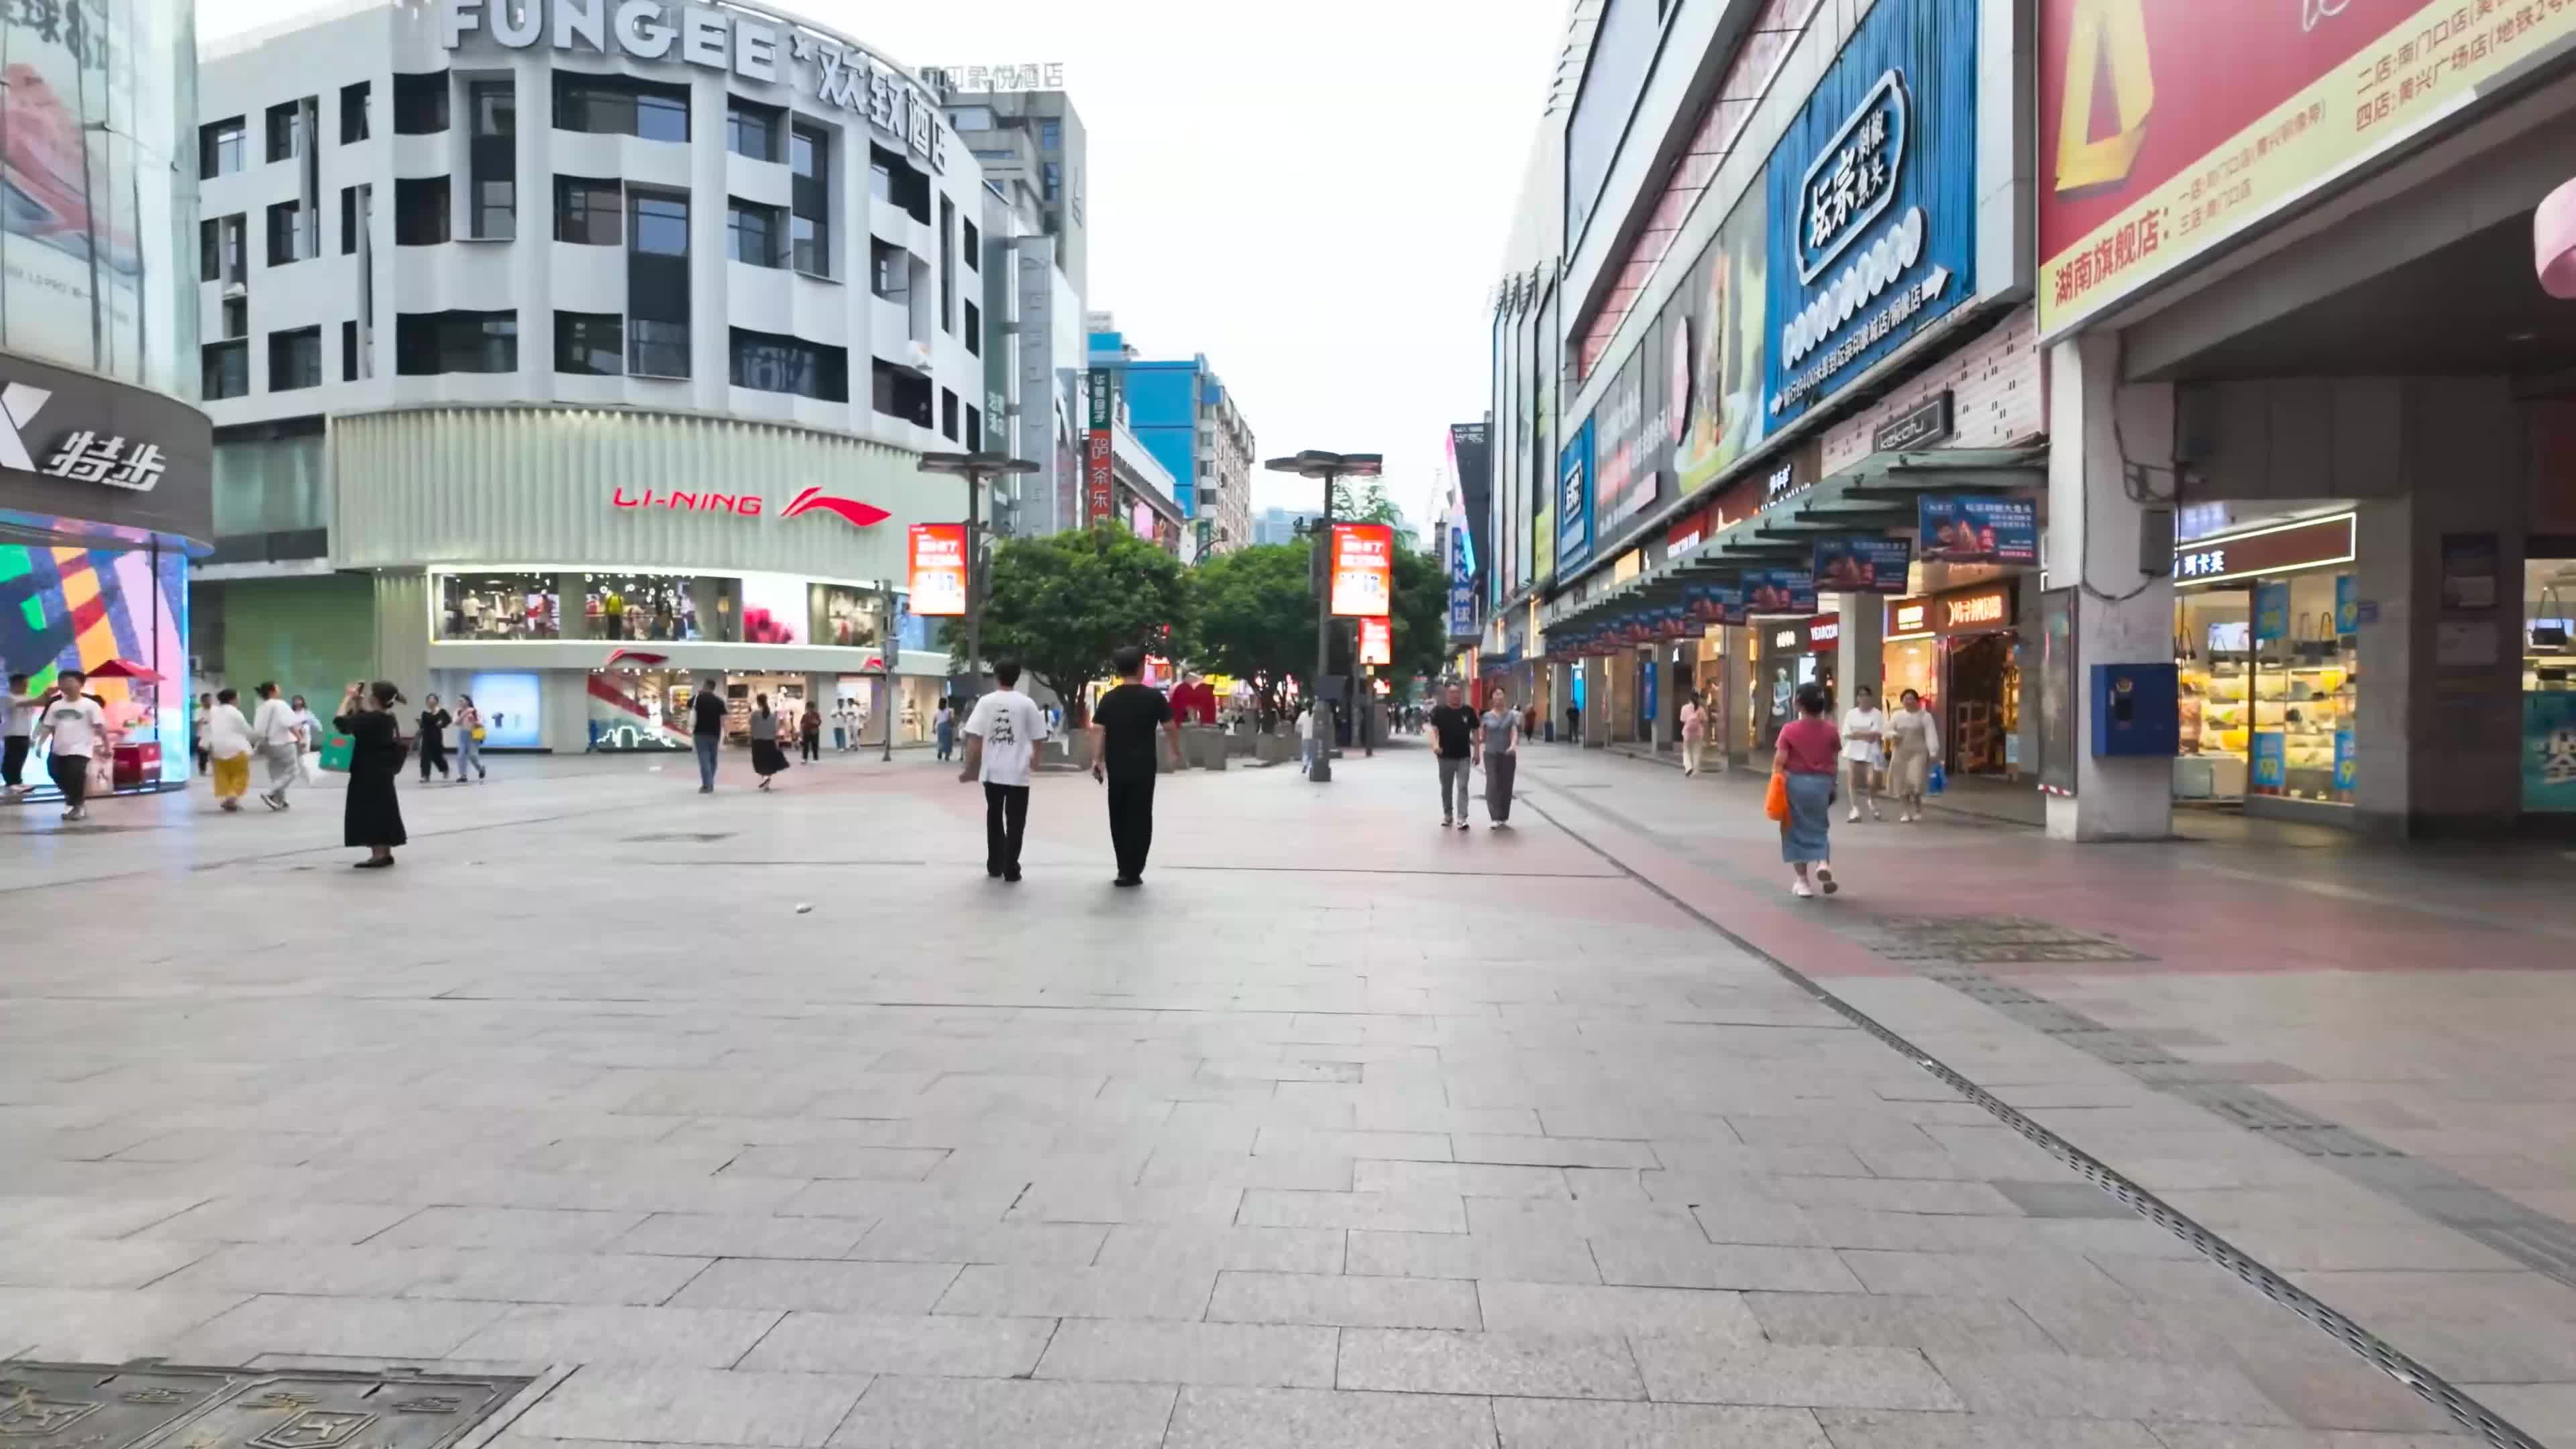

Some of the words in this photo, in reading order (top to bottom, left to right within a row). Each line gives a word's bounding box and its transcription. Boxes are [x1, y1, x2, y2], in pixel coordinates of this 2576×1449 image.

[442, 0, 777, 84] FUNGEE
[817, 44, 945, 176] 欢致酒店
[1809, 149, 1857, 250] 坛宗
[43, 431, 166, 492] 特步
[613, 488, 763, 515] LI-NING
